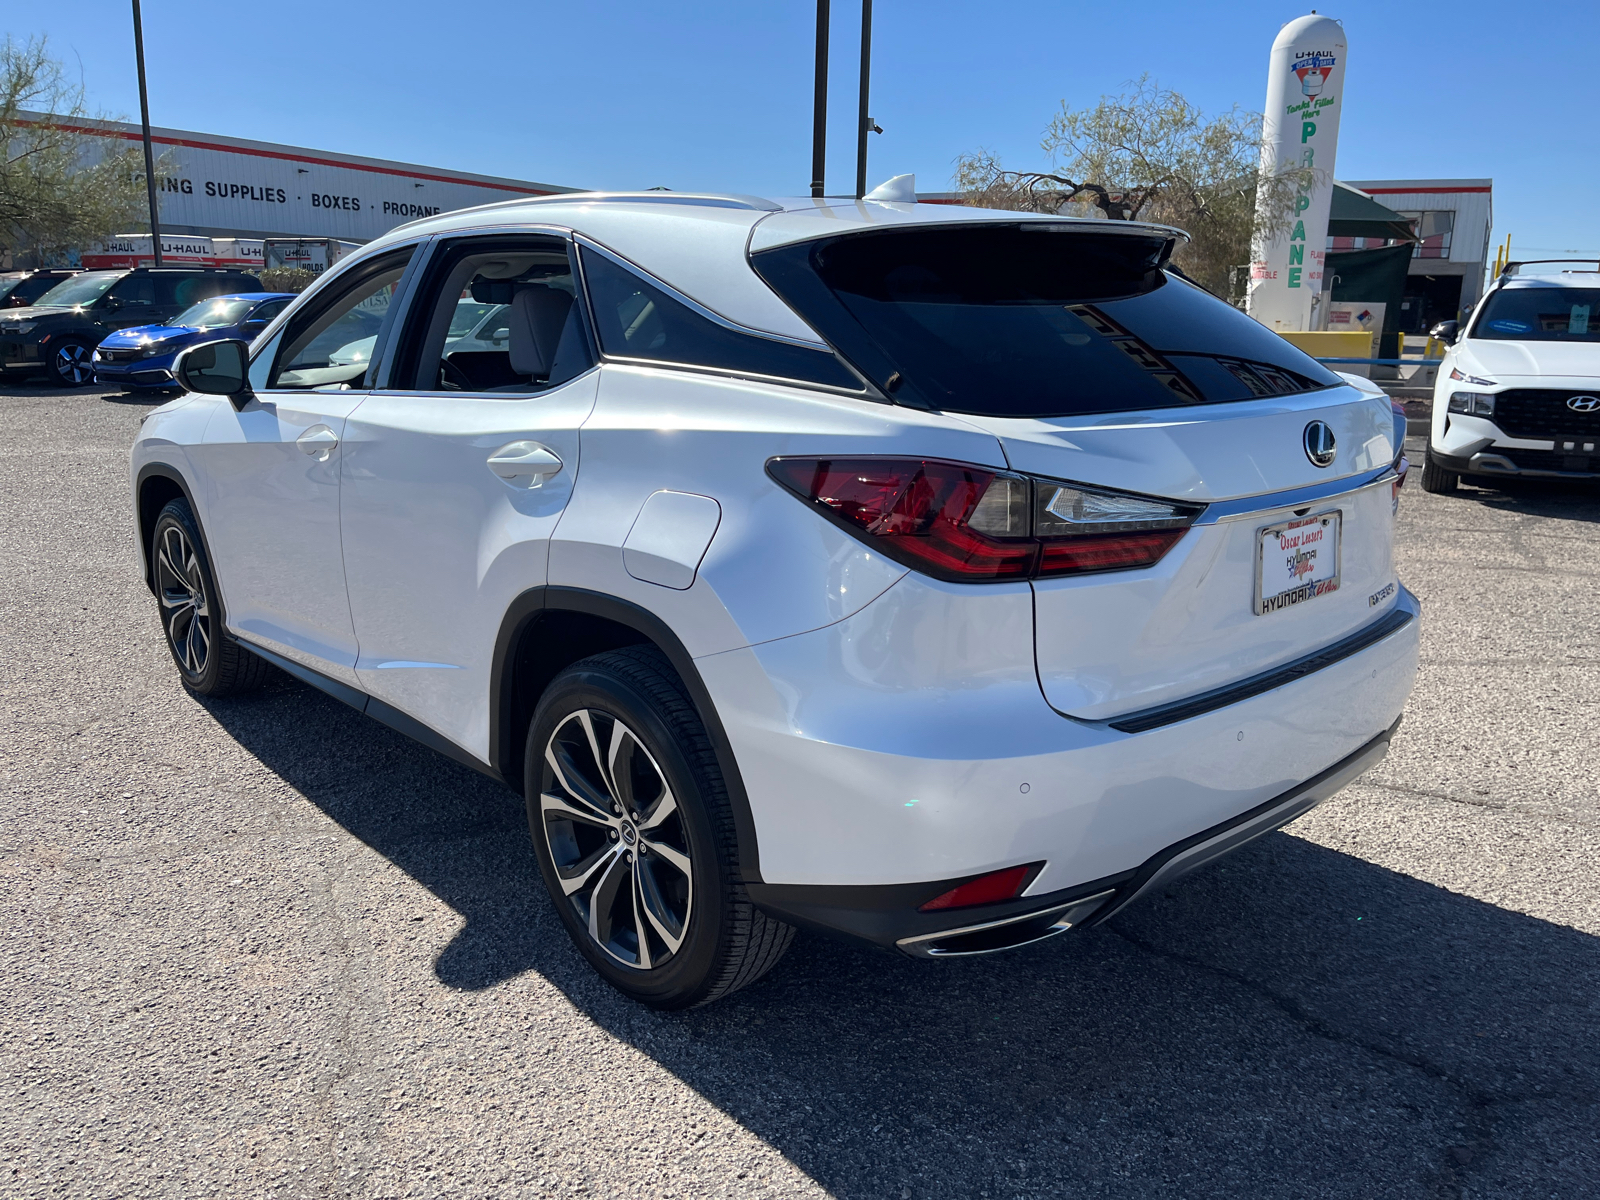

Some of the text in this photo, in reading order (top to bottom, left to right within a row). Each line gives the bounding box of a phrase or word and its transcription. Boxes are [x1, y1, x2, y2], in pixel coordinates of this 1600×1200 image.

[1295, 51, 1334, 59] U-HAUL
[1296, 60, 1312, 69] OPEN
[1286, 96, 1334, 115] Tanks Filled
[1301, 109, 1320, 120] Here
[205, 181, 286, 204] SUPPLIES
[311, 193, 361, 211] BOXES
[383, 201, 440, 218] PROPANE
[161, 243, 210, 254] U-HAUL
[1280, 526, 1323, 551] Oscar Leeser's
[1286, 549, 1317, 567] HYUNDAI
[1262, 587, 1307, 614] HYUNDAI
